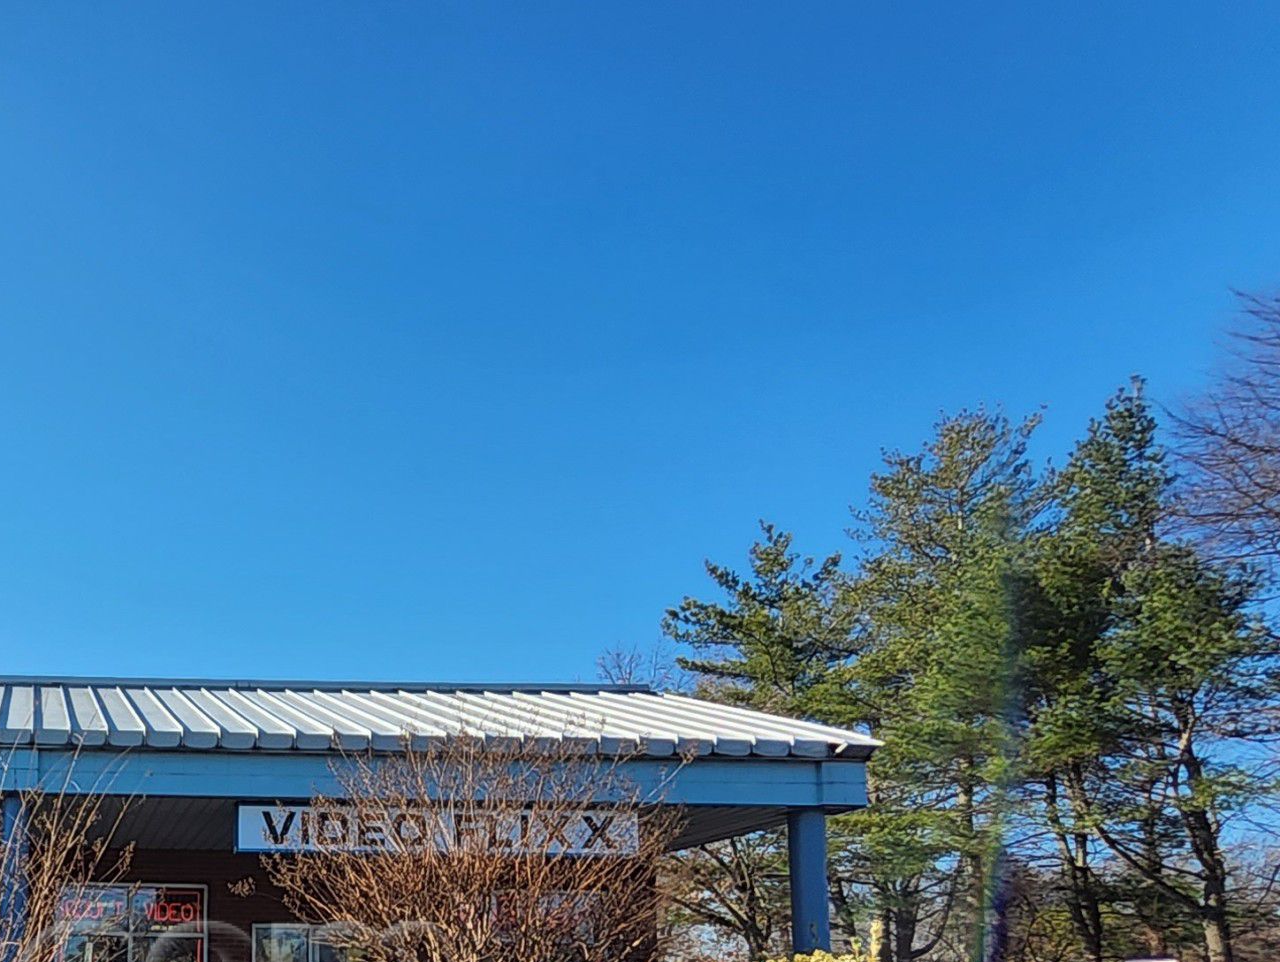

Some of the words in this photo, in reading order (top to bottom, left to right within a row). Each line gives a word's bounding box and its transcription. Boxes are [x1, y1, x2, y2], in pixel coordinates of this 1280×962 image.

[261, 810, 426, 846] VIDEO
[454, 812, 617, 852] FLIXX
[143, 901, 194, 922] VIDEO
